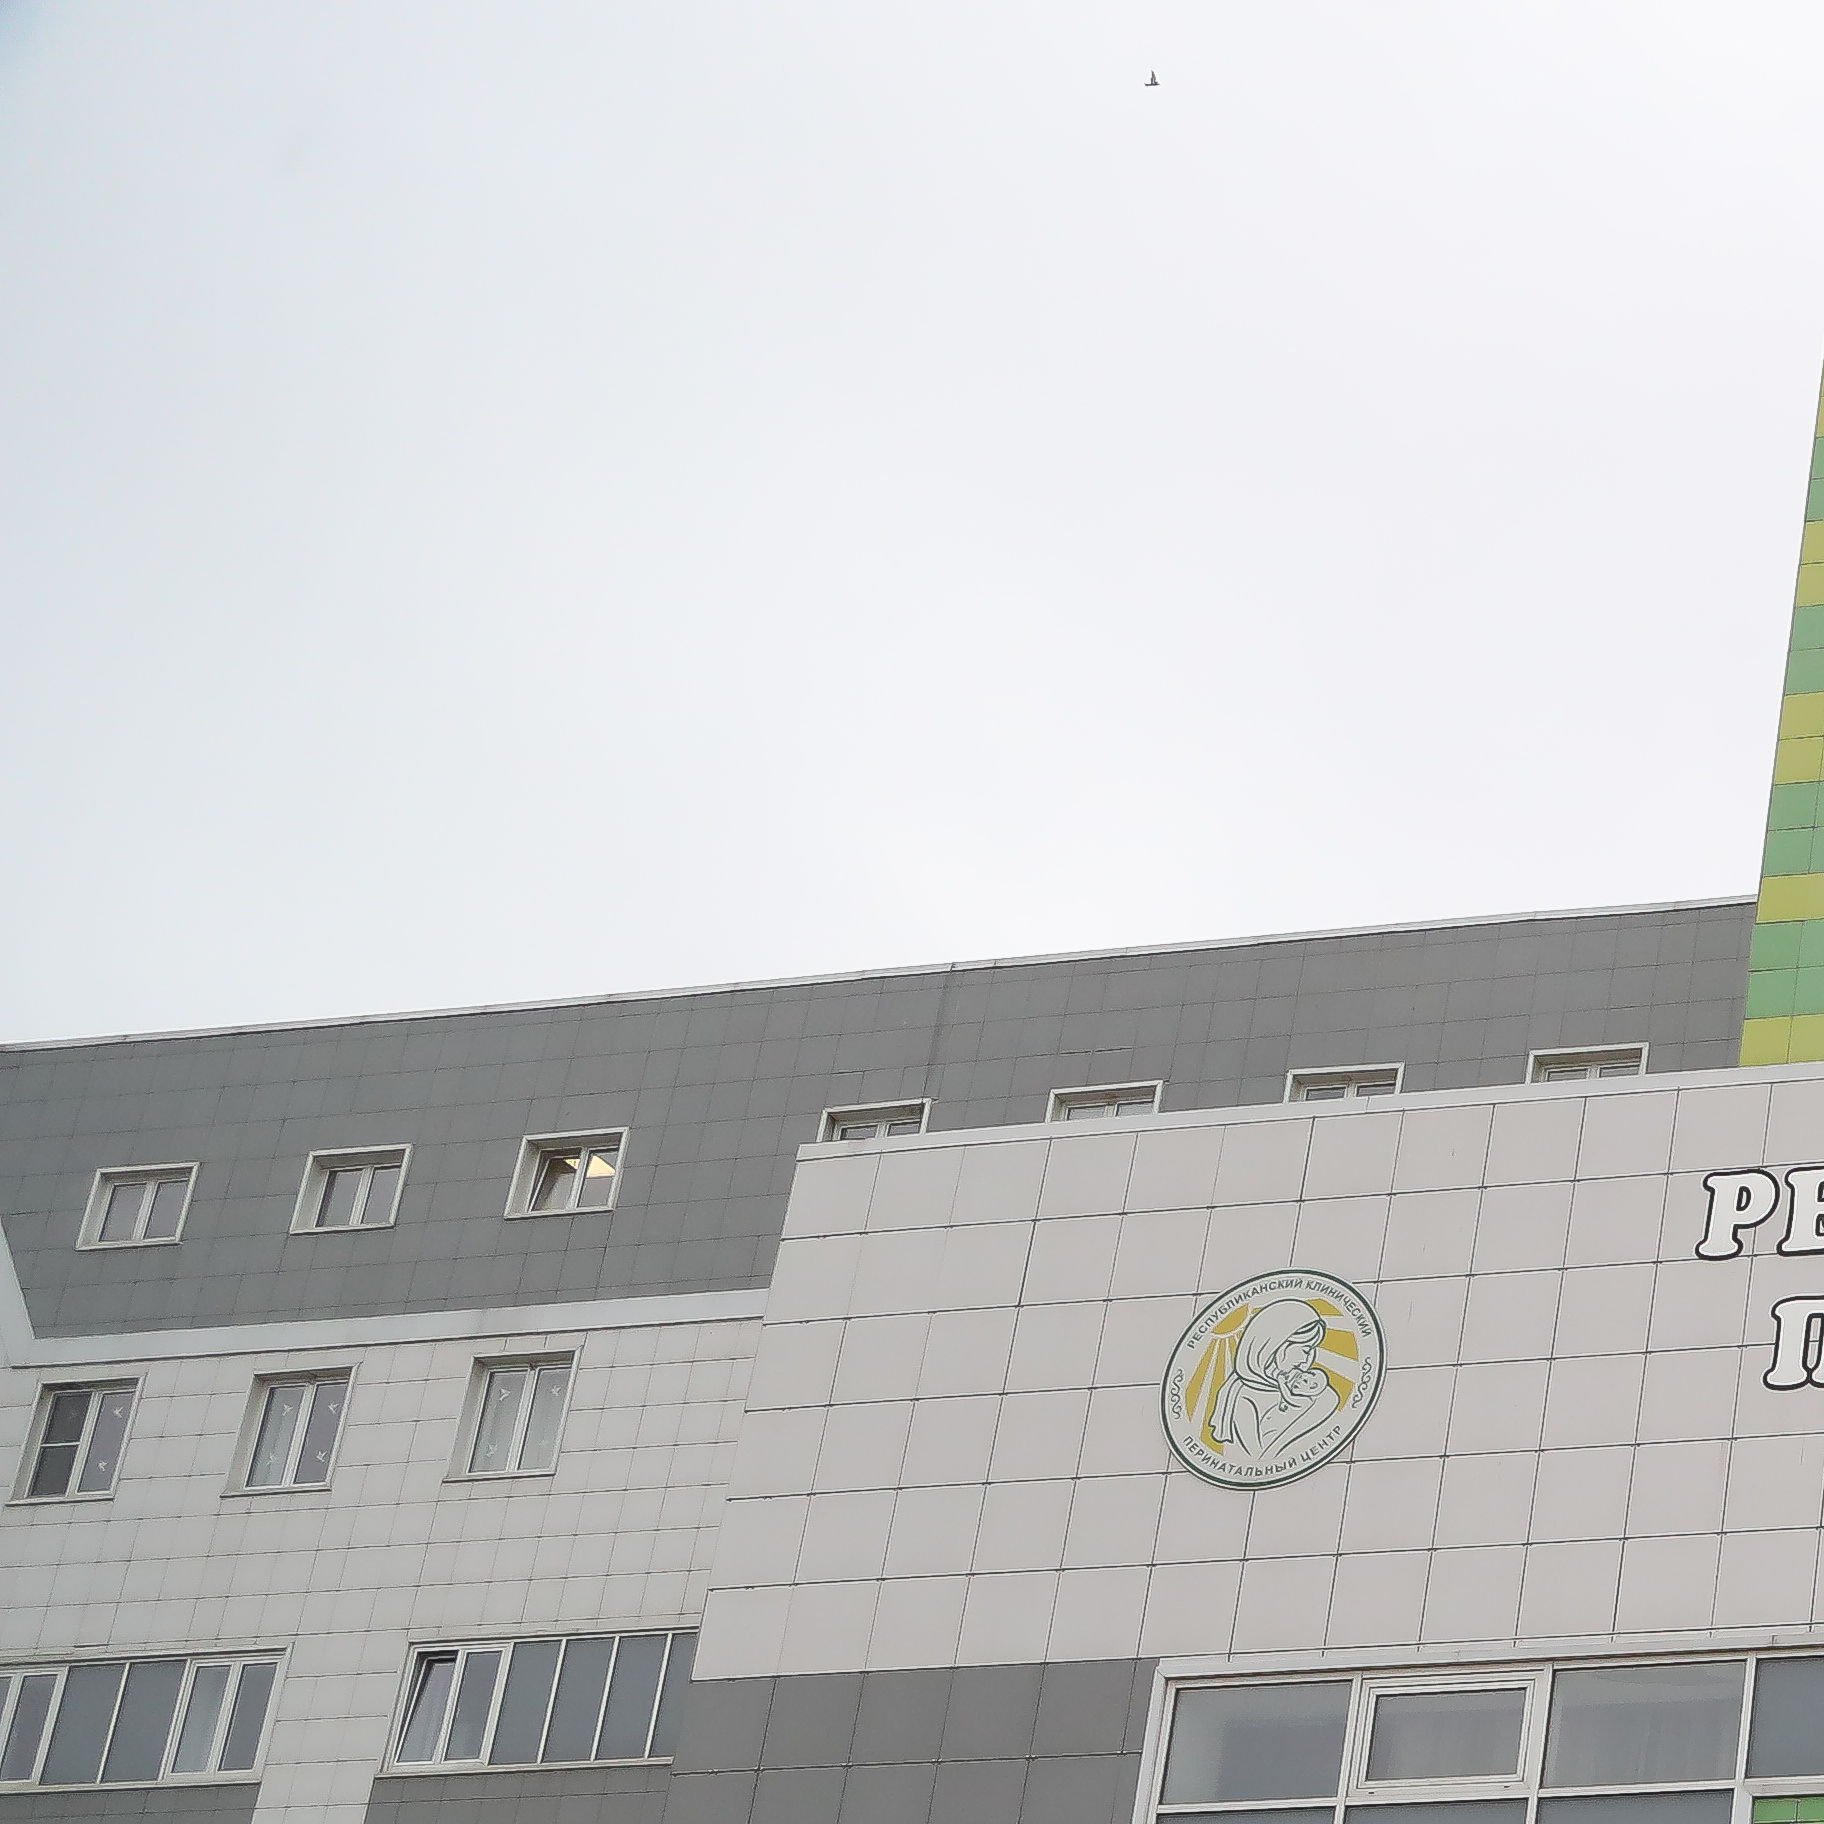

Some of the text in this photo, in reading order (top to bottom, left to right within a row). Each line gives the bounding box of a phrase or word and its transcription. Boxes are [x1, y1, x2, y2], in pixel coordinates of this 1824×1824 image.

[1186, 1278, 1374, 1351] РЕСПУБЛИКАНСКИЙ КЛИНИЧЕСКИЙ
[1182, 1425, 1343, 1478] ПЕРИНАТАЛЬНЫЙ ЦЕНТР
